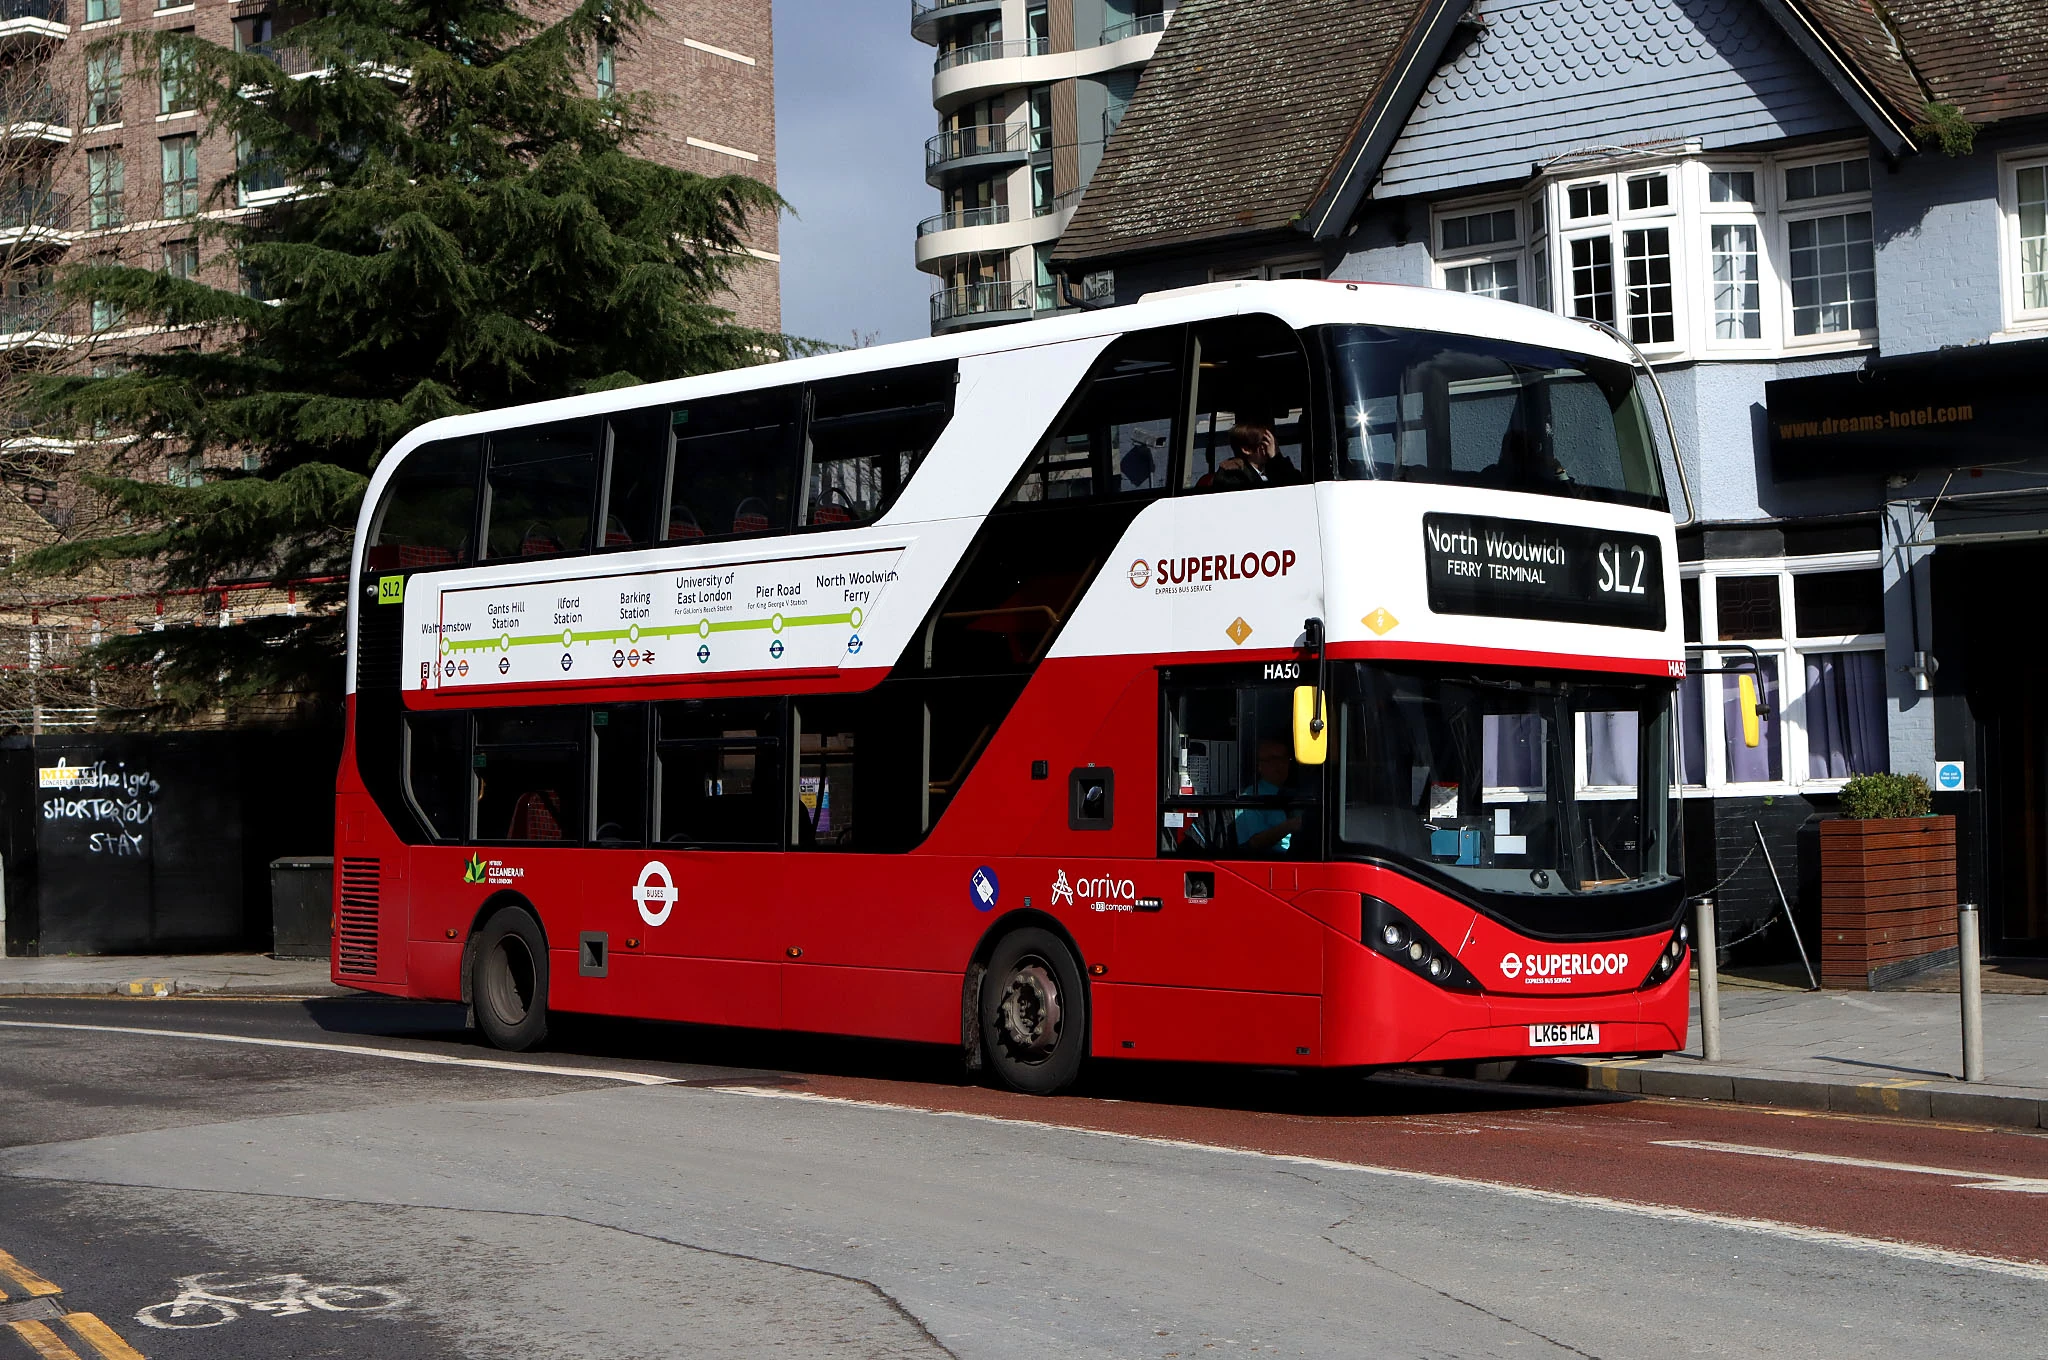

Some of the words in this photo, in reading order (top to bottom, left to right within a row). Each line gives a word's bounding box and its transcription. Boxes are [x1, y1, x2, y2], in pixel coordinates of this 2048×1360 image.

[1779, 405, 1973, 439] www.dreams-hotel.com
[1427, 523, 1478, 555] North
[1484, 528, 1565, 565] Woolwich
[1156, 549, 1296, 585] SUPERLOOP
[1447, 560, 1482, 577] FERRY
[1488, 563, 1546, 584] TERMINAL
[1598, 541, 1645, 594] SL2
[676, 574, 723, 589] University
[724, 572, 735, 584] of
[816, 573, 846, 588] North
[382, 581, 400, 598] SL2
[677, 592, 697, 605] East
[698, 589, 732, 603] London
[756, 586, 774, 598] Pier
[777, 583, 801, 596] Road
[844, 589, 870, 603] Ferry
[1155, 586, 1178, 595] EXPRESS
[1179, 585, 1189, 593] BUS
[1190, 584, 1212, 593] SERVICE
[557, 597, 580, 609] Ilford
[620, 592, 651, 605] Barking
[747, 602, 756, 610] For
[756, 601, 767, 610] King
[767, 600, 785, 609] George
[790, 599, 808, 607] Station
[487, 603, 510, 615] Gants
[511, 601, 525, 613] Hill
[620, 606, 650, 620] Station
[492, 617, 519, 629] Station
[553, 612, 583, 625] Station
[1264, 663, 1300, 680] HA50
[116, 798, 153, 824] YOU
[646, 889, 664, 898] BUSES
[1076, 873, 1135, 900] arriva
[1525, 953, 1629, 976] SUPERLOOP
[1553, 976, 1572, 984] SERVICE
[1534, 1024, 1568, 1043] LK66
[1570, 1023, 1594, 1041] HCA
